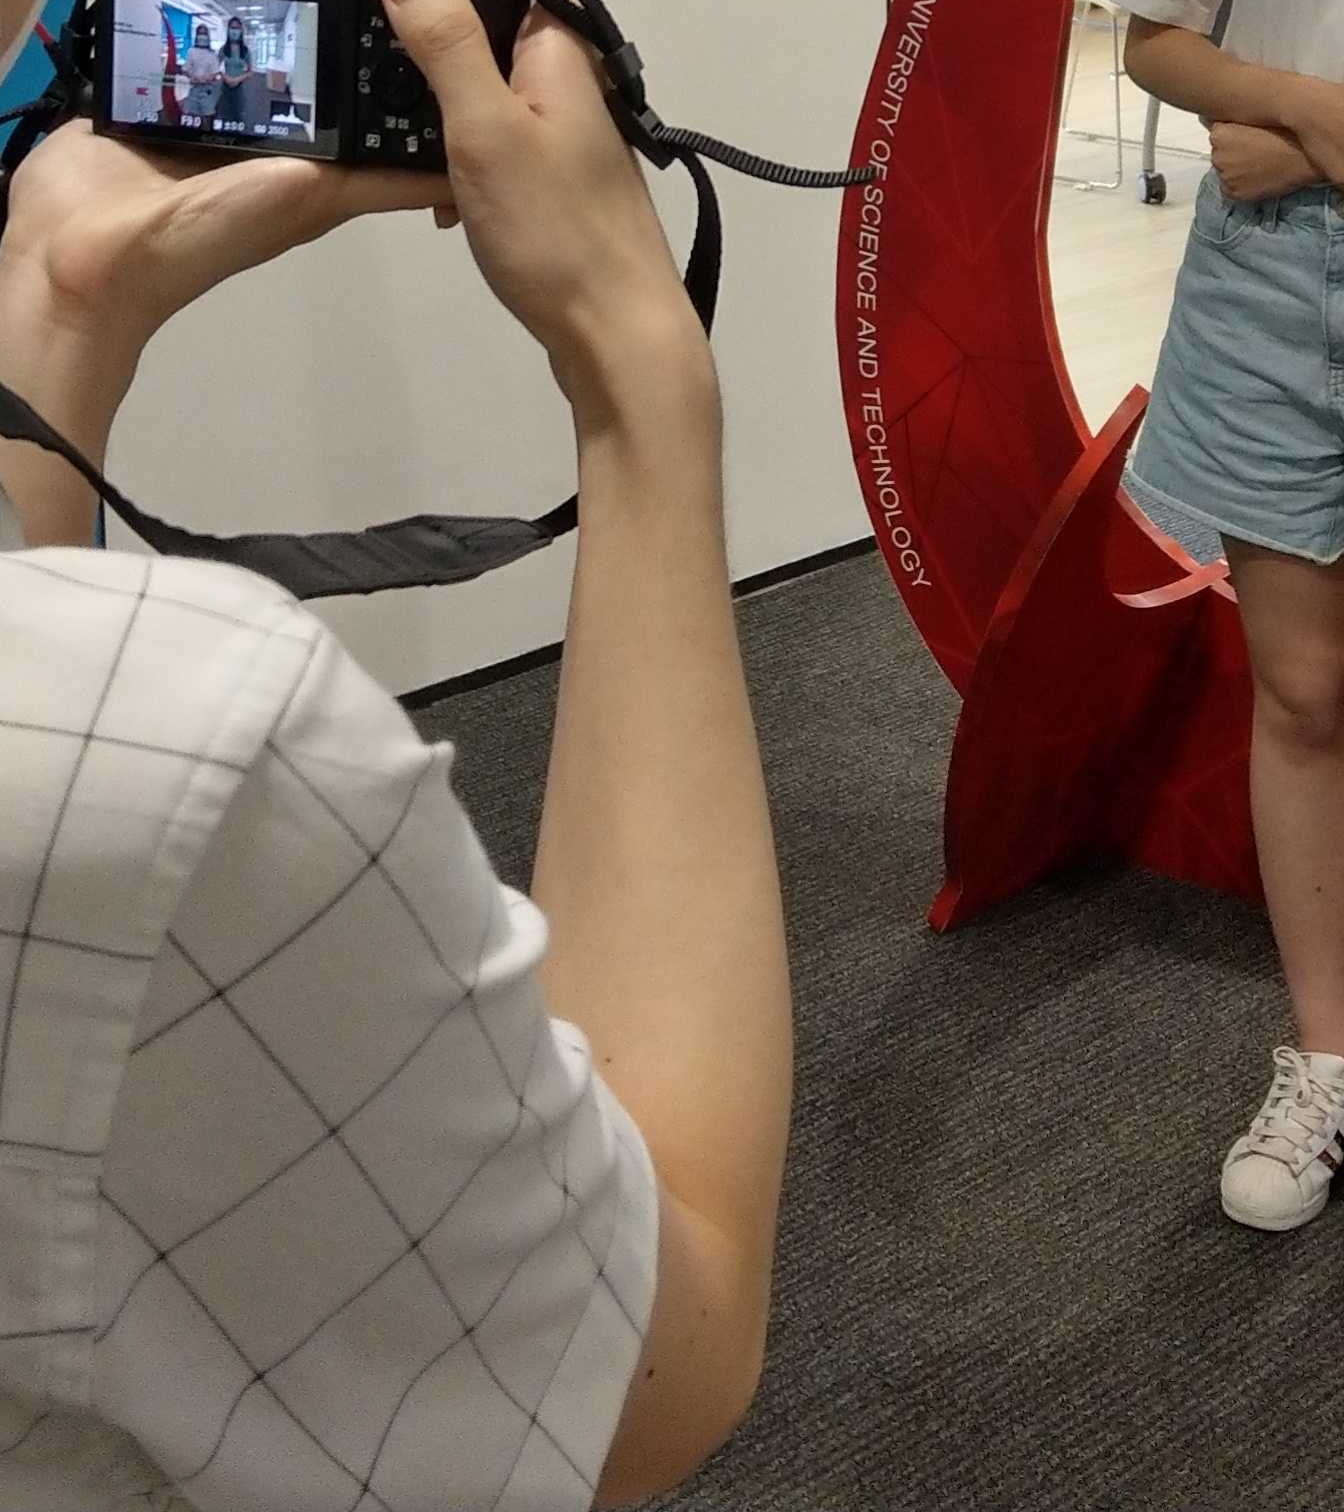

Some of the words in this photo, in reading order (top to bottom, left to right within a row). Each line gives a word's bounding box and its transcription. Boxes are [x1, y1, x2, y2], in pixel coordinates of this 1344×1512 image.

[868, 139, 892, 182] OF
[856, 184, 884, 312] SCIENCE
[856, 316, 879, 379] AND
[861, 387, 932, 588] TECHNOLOGY
